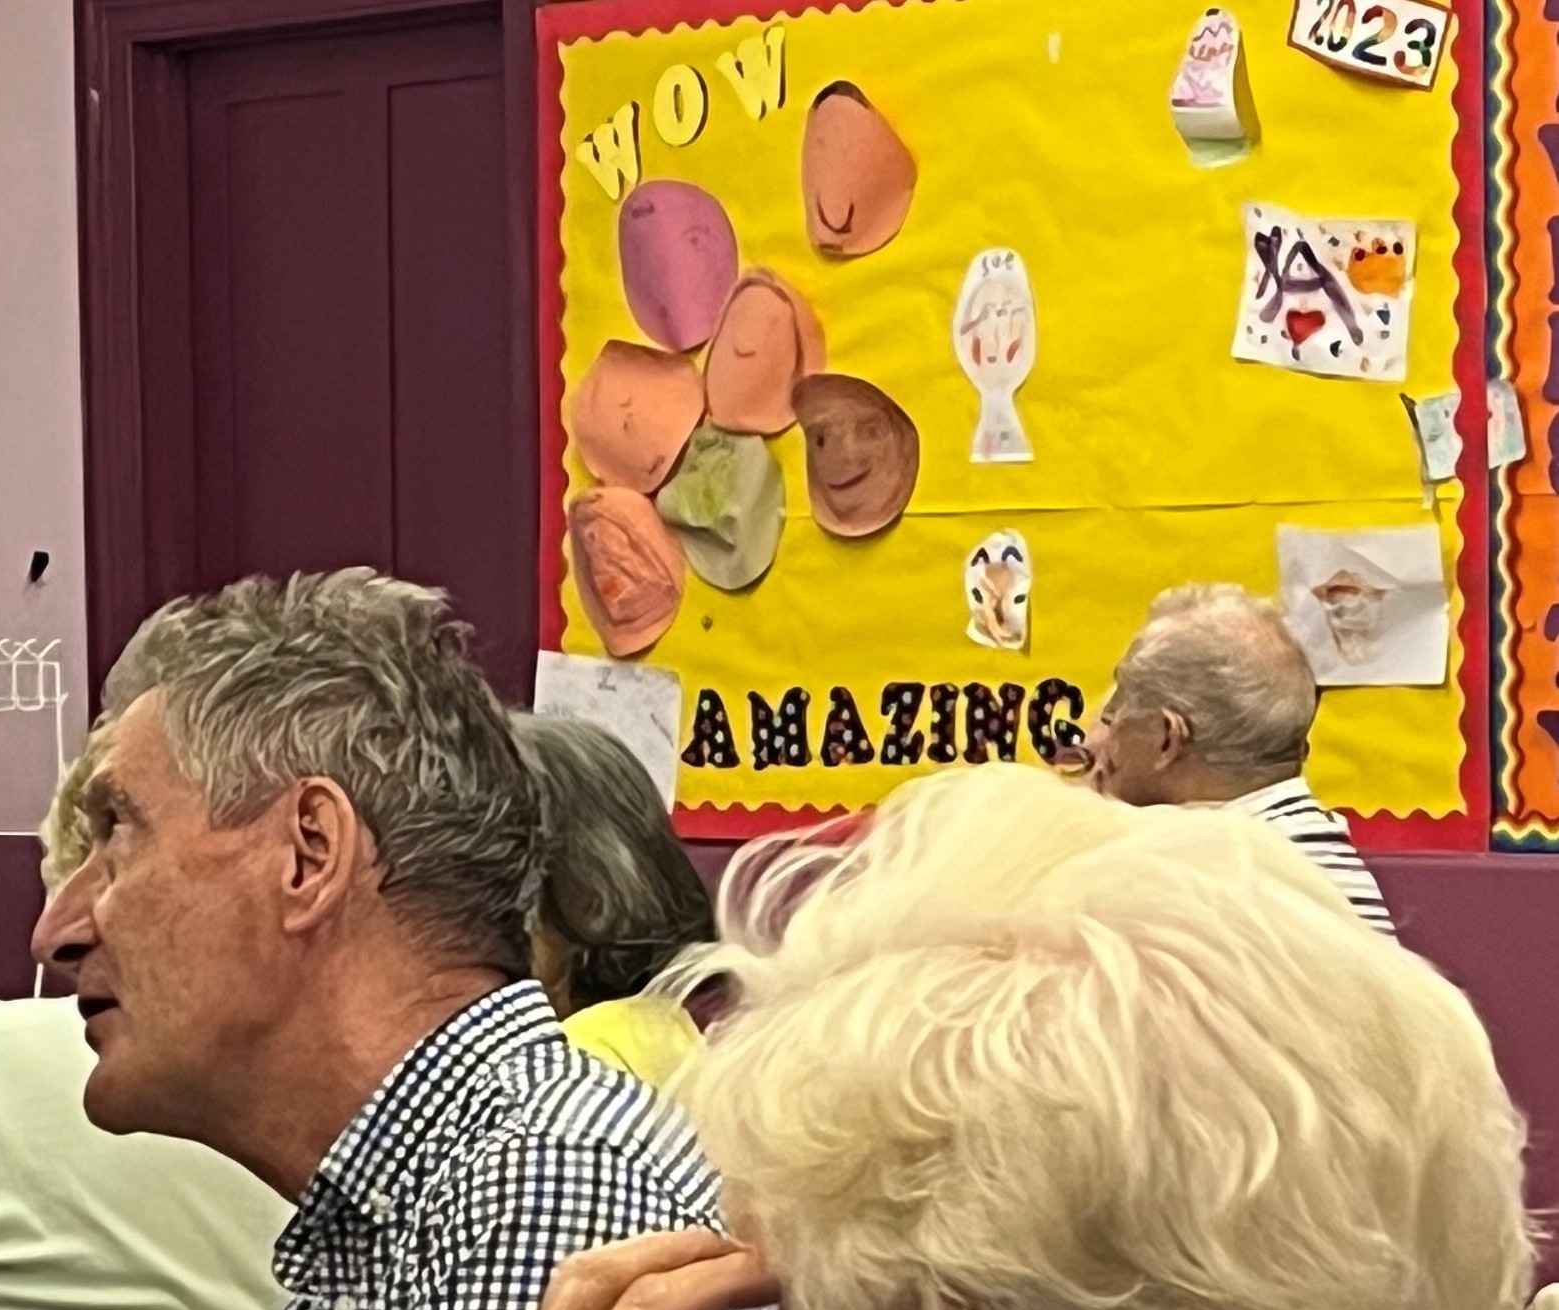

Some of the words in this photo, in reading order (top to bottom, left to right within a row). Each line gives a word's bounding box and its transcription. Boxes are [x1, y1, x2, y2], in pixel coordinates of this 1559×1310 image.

[1308, 0, 1437, 76] 2023
[575, 23, 785, 200] WOW
[681, 677, 1086, 771] AMAZING
